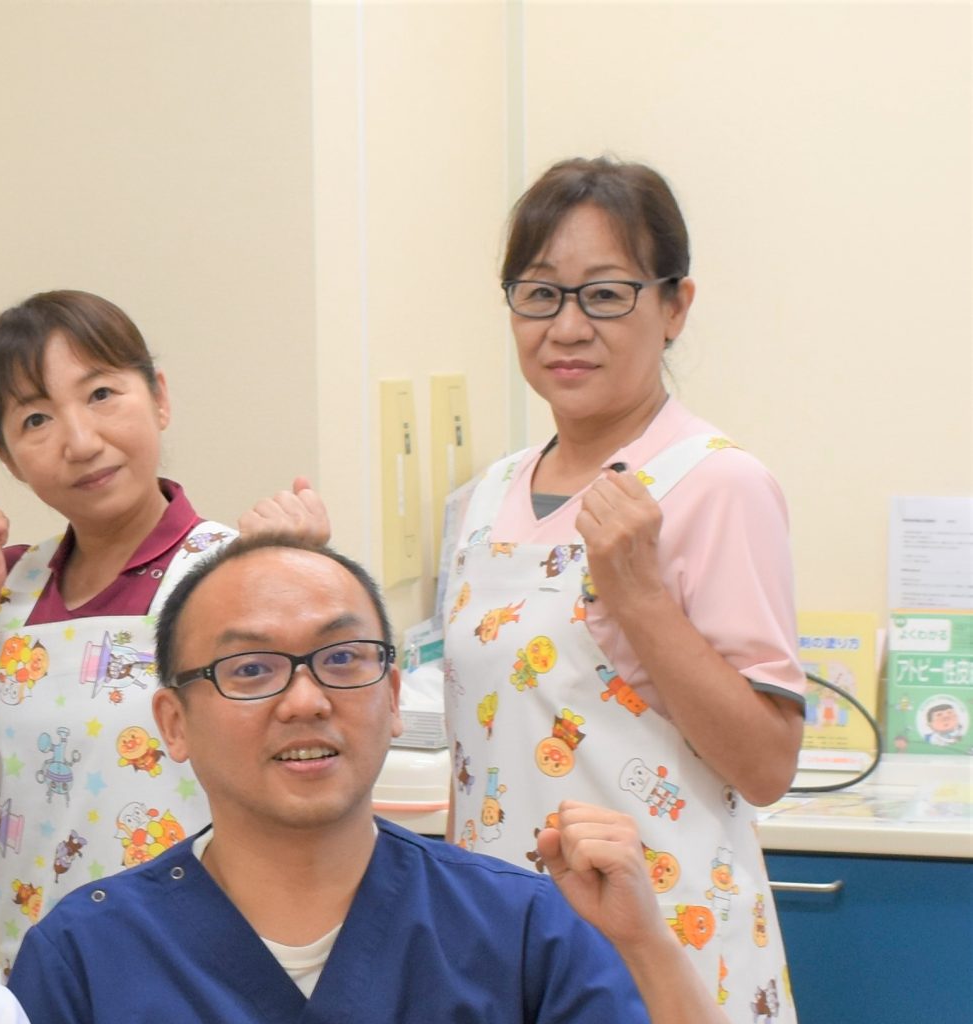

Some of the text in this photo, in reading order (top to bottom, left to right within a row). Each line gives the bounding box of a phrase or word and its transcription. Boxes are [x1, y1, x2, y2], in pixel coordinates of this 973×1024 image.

[896, 656, 973, 685] アトピー性皮
